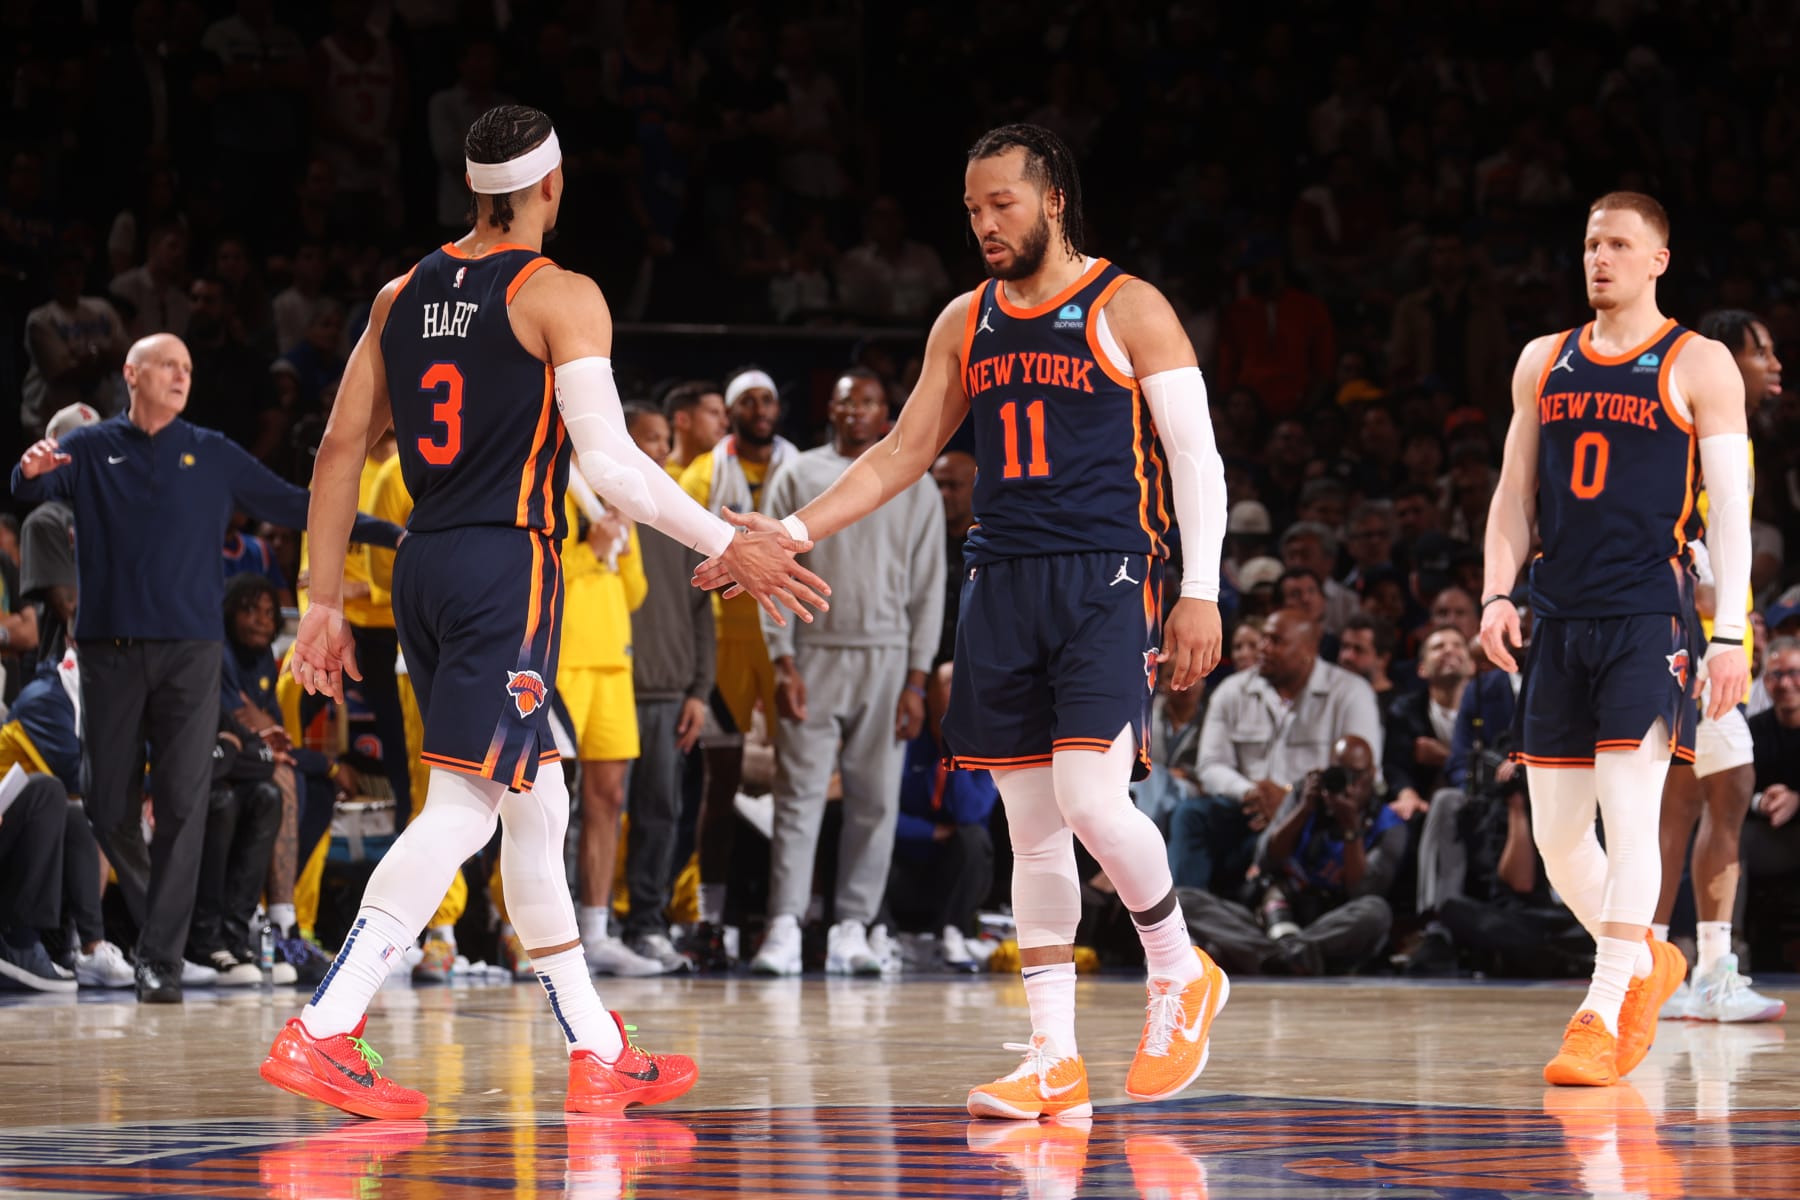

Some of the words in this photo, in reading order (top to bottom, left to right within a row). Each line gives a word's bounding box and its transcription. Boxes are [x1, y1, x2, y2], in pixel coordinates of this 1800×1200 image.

[423, 301, 478, 338] HART
[1054, 320, 1085, 329] sphere
[969, 353, 1016, 398] NEW
[1019, 352, 1094, 393] YORK
[417, 363, 464, 465] 3
[1541, 391, 1592, 425] NEW
[1594, 391, 1660, 431] YORK
[999, 399, 1050, 479] 11
[1570, 431, 1610, 499] 0
